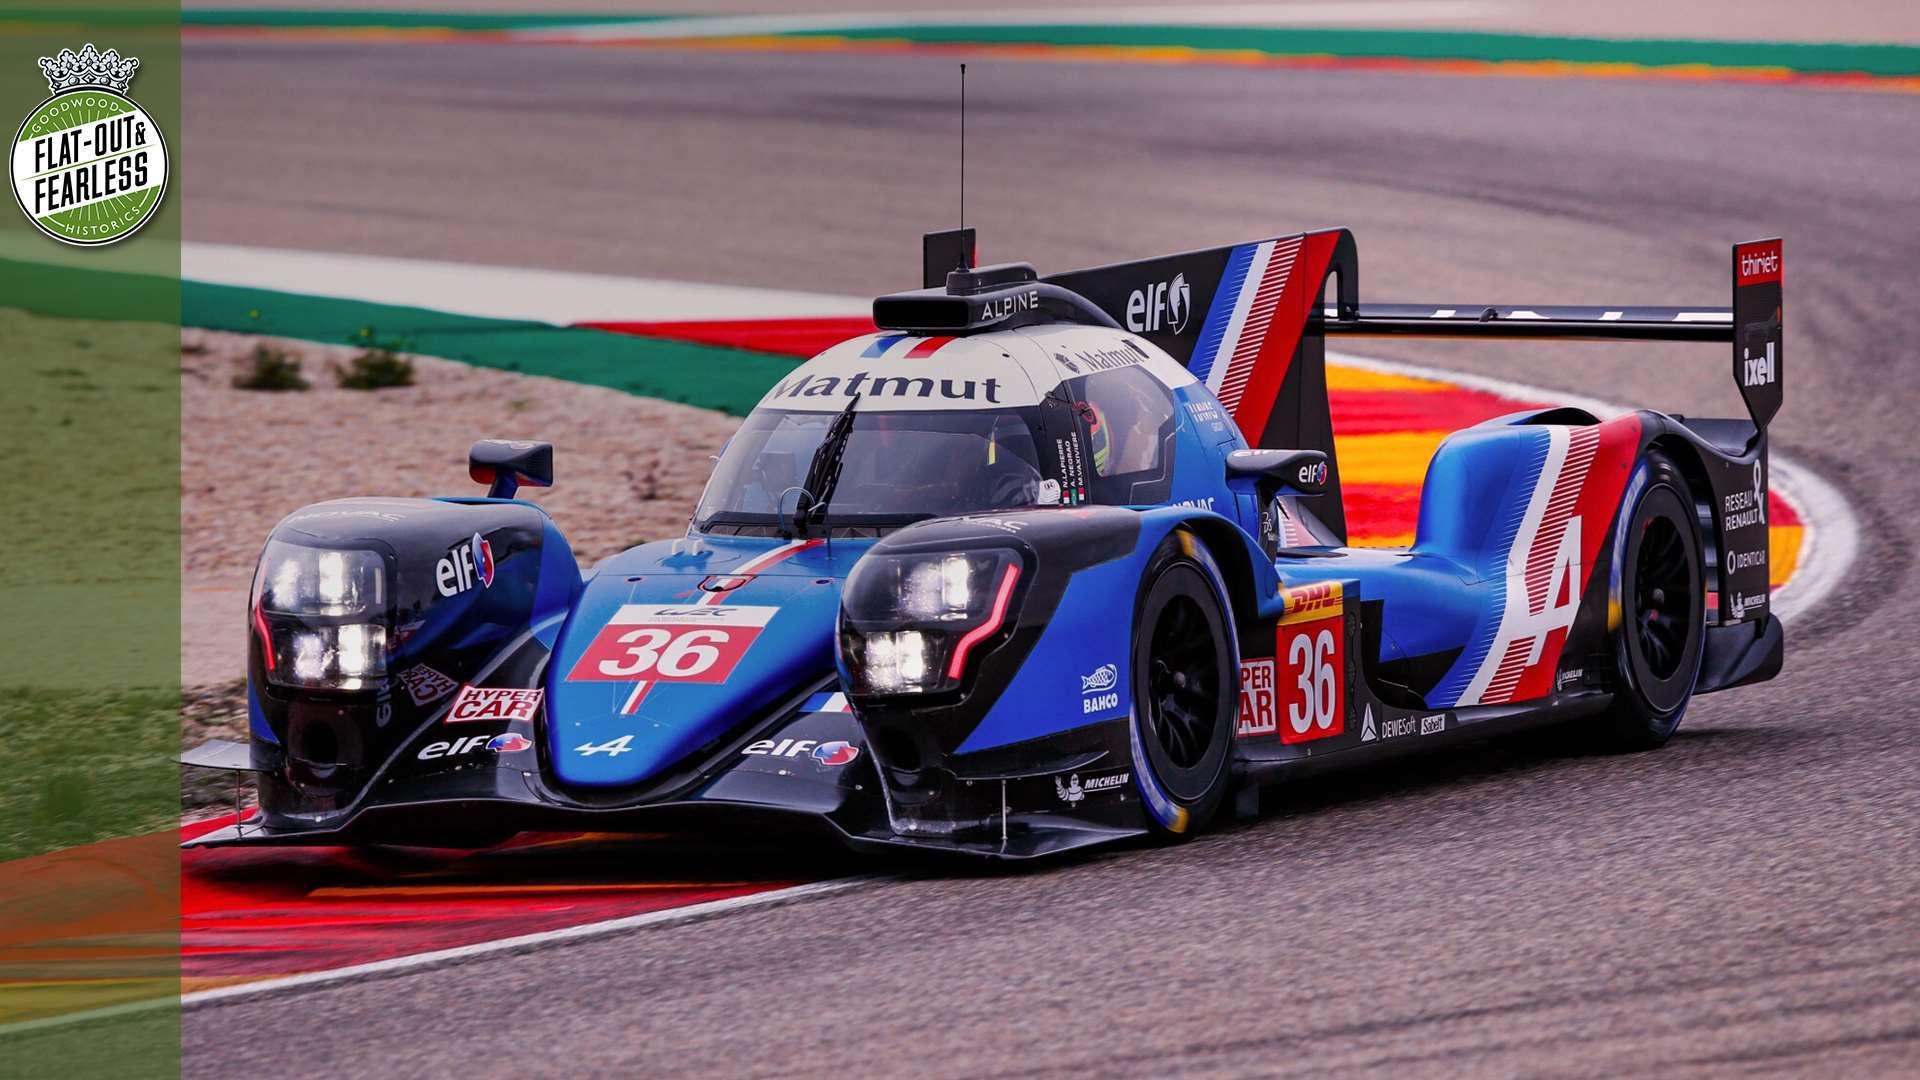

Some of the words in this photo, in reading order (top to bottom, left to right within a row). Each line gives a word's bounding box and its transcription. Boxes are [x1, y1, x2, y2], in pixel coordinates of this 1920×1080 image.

[1741, 250, 1778, 277] thiriet
[981, 290, 1039, 320] ALPINE
[1126, 281, 1167, 333] elf
[1075, 346, 1143, 372] Matmut
[1744, 342, 1775, 386] ixell
[774, 371, 1001, 404] Matmut
[1298, 464, 1318, 483] elf
[1724, 490, 1753, 513] RESEAU
[1725, 508, 1759, 532] RENAULT
[436, 544, 474, 597] elf
[1290, 584, 1335, 614] DHL
[598, 628, 730, 677] 36
[1240, 665, 1272, 690] PER
[1288, 629, 1336, 733] 36
[463, 690, 539, 702] HYPER
[1083, 693, 1119, 714] BAHCO
[453, 700, 534, 719] CAR
[1239, 690, 1273, 728] AR
[1382, 715, 1417, 738] DEWESoft
[417, 735, 491, 760] elf
[741, 739, 818, 757] elf
[1084, 772, 1130, 790] MICHELIN
